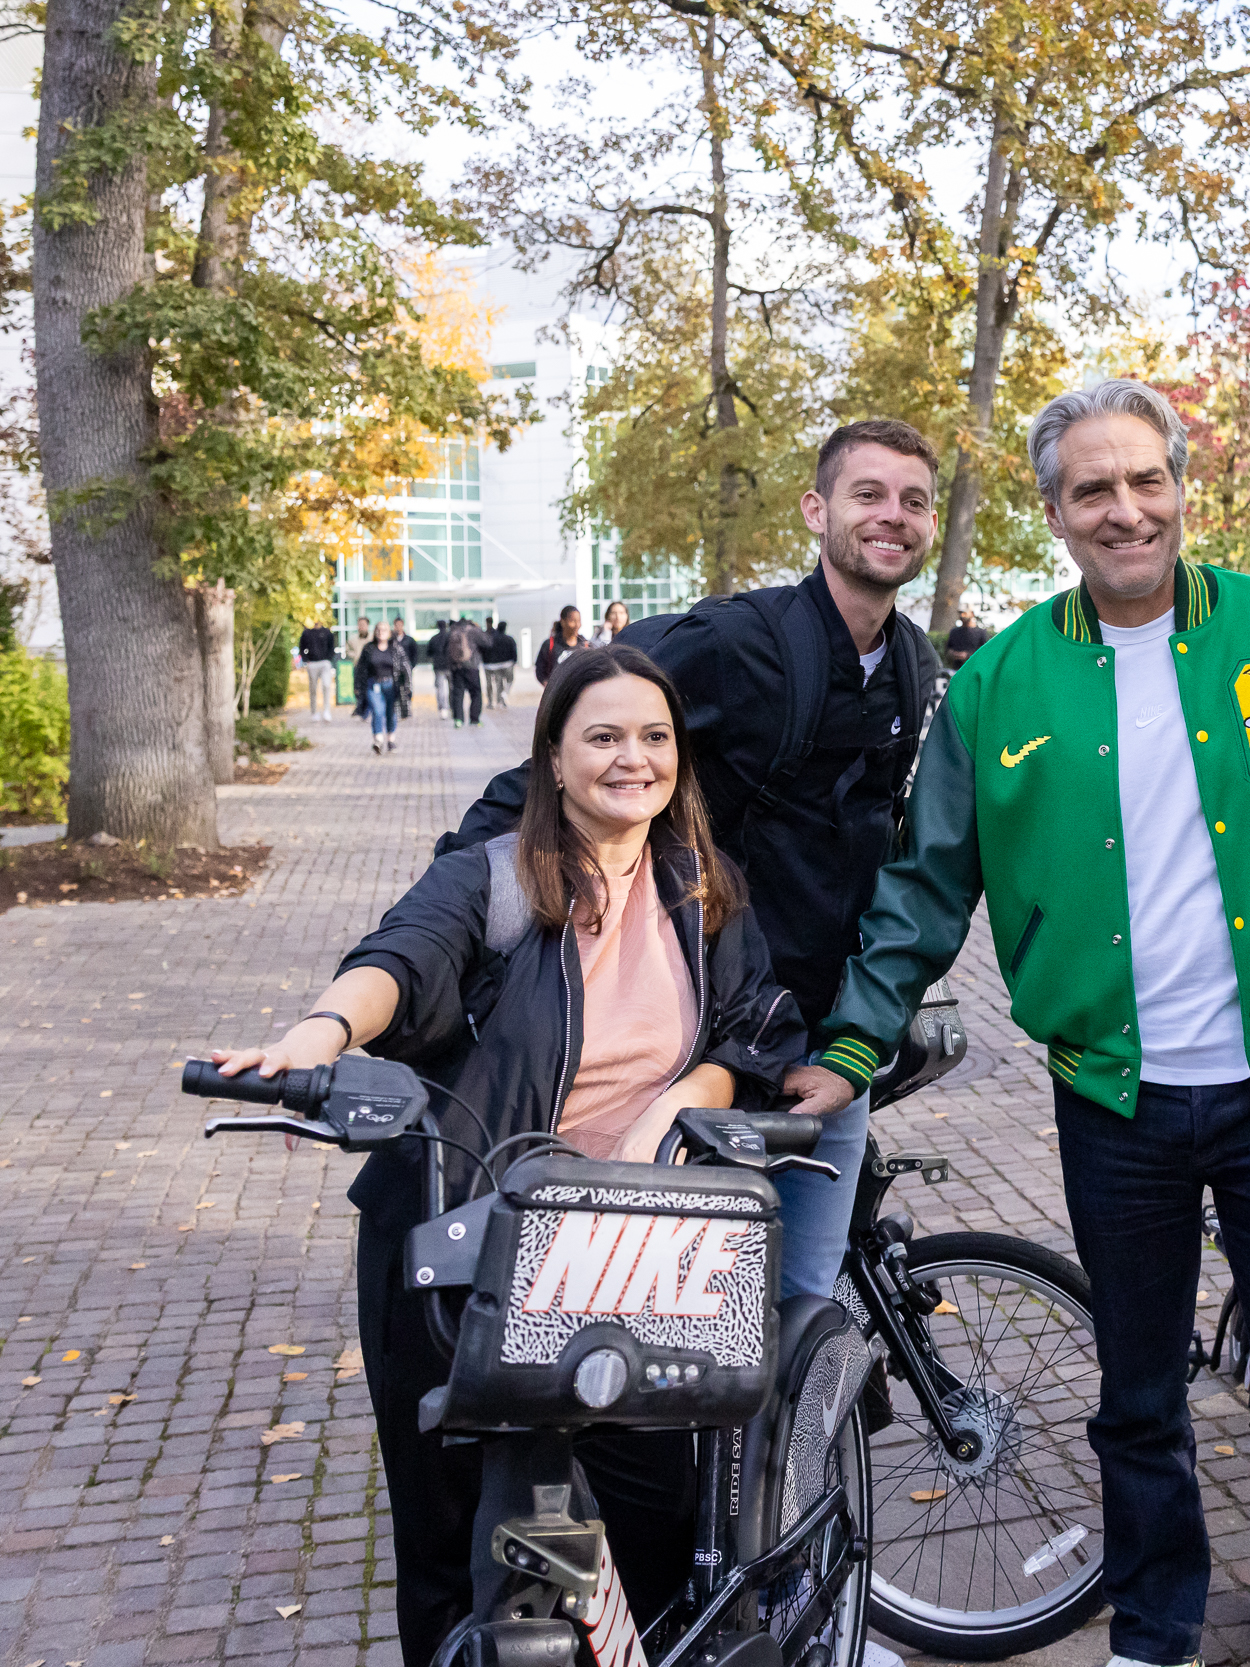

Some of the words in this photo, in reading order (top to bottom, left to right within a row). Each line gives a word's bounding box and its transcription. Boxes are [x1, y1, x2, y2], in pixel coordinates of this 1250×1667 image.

[1140, 704, 1163, 718] NIKE
[522, 1210, 750, 1317] NIKE
[729, 1463, 741, 1516] RIDE
[694, 1552, 718, 1562] PBSC
[510, 1643, 531, 1654] AXA
